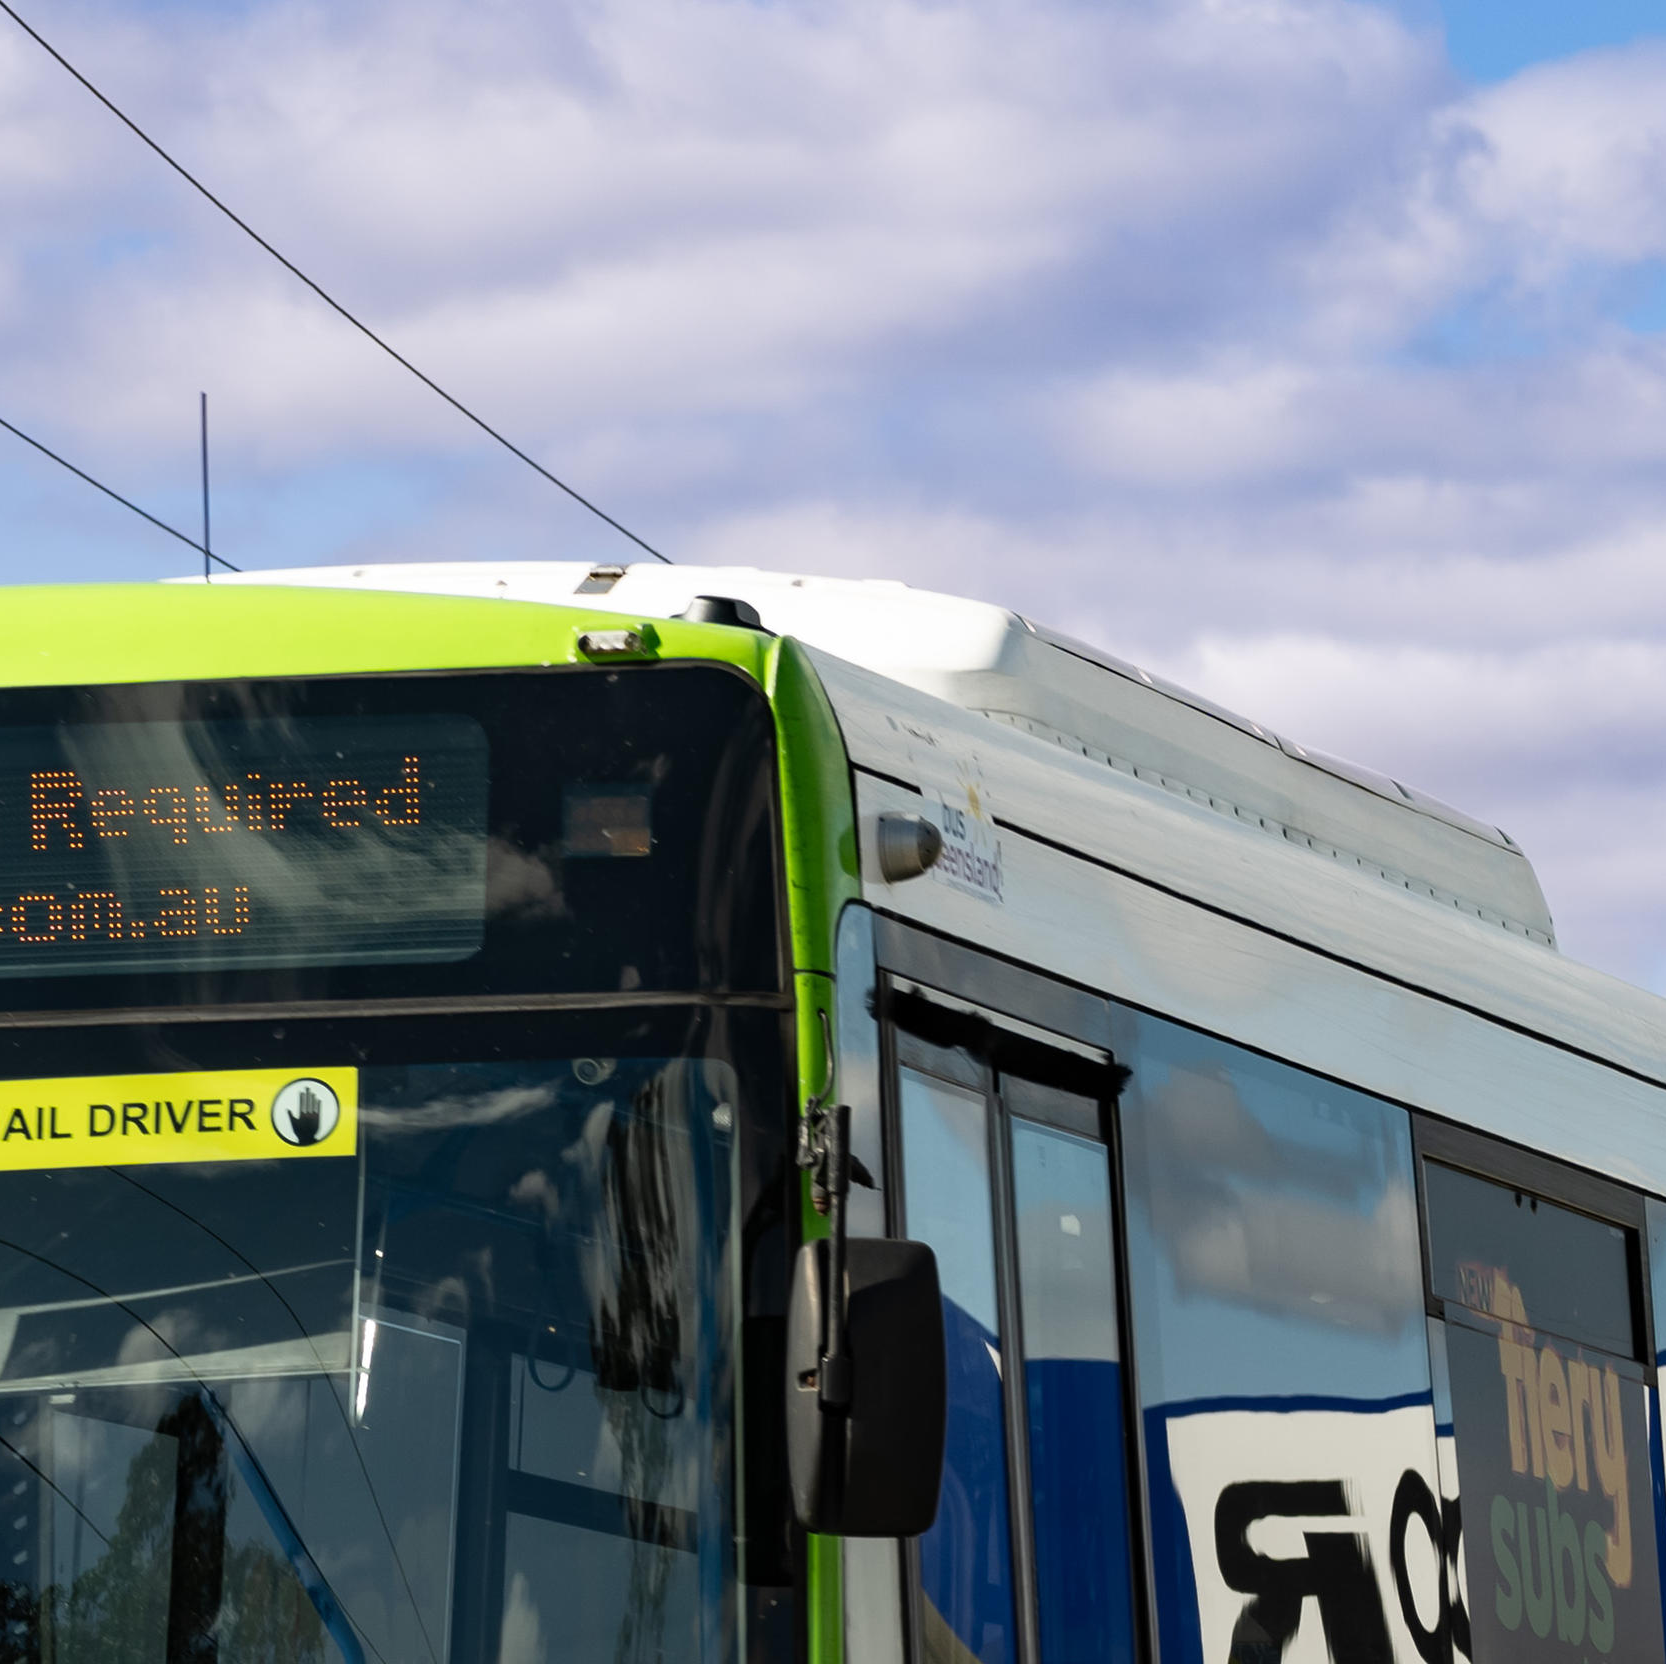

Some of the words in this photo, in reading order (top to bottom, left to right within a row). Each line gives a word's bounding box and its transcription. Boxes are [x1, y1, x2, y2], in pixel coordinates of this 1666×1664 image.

[30, 756, 421, 850] Required
[89, 1098, 258, 1137] DRIVER
[1490, 1475, 1614, 1655] subs
